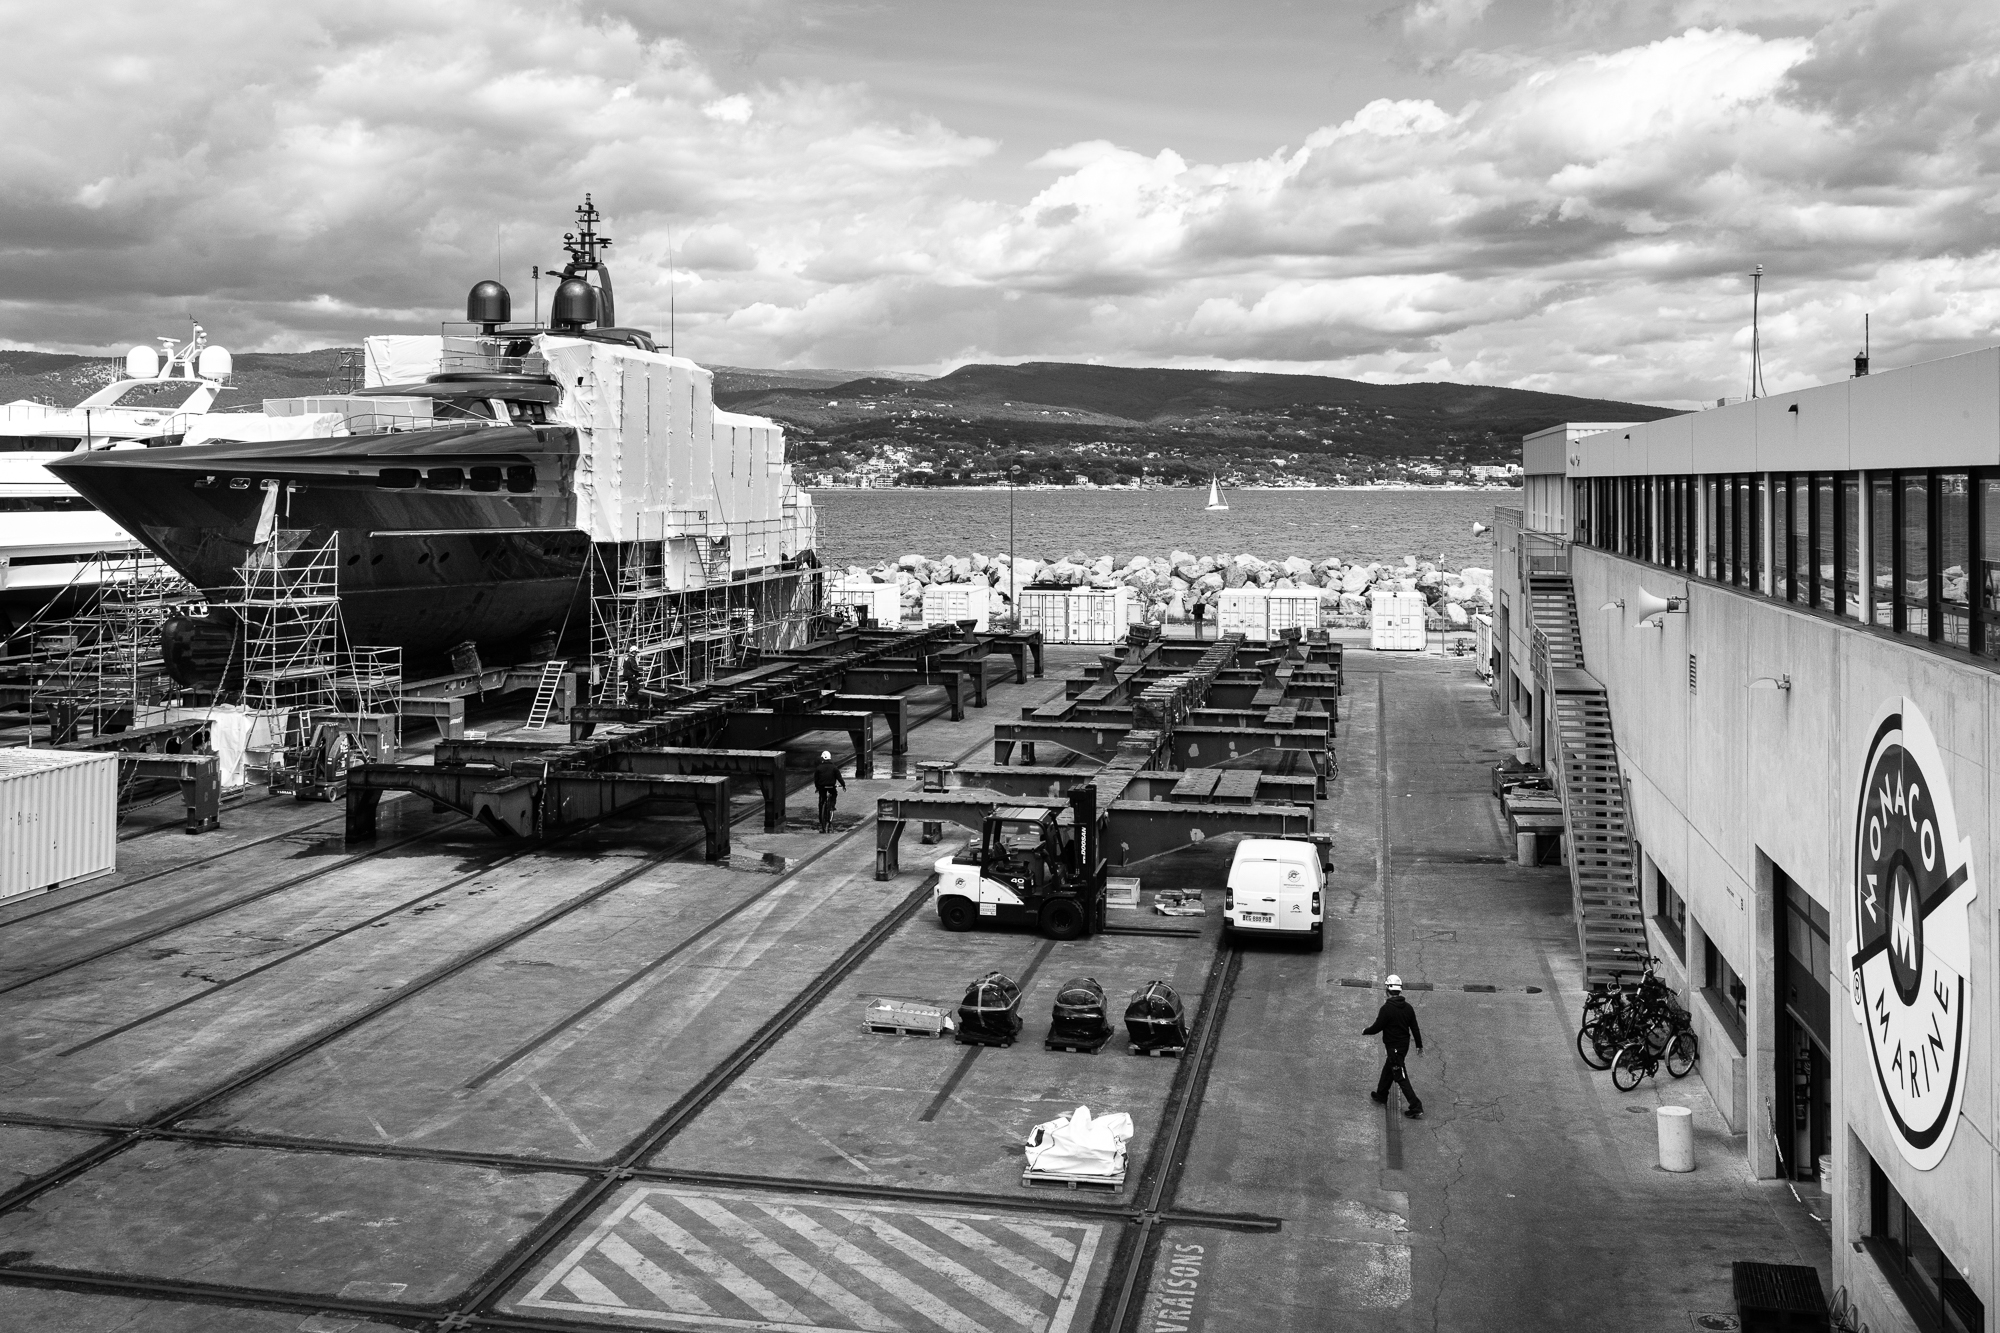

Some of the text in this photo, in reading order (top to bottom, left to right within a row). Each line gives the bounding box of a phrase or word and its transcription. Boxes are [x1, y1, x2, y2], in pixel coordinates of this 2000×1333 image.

[1864, 769, 1936, 923] MONACO
[1891, 873, 1917, 972] M
[1876, 970, 1950, 1098] MARINE
[1155, 1243, 1205, 1333] VRAISONS
